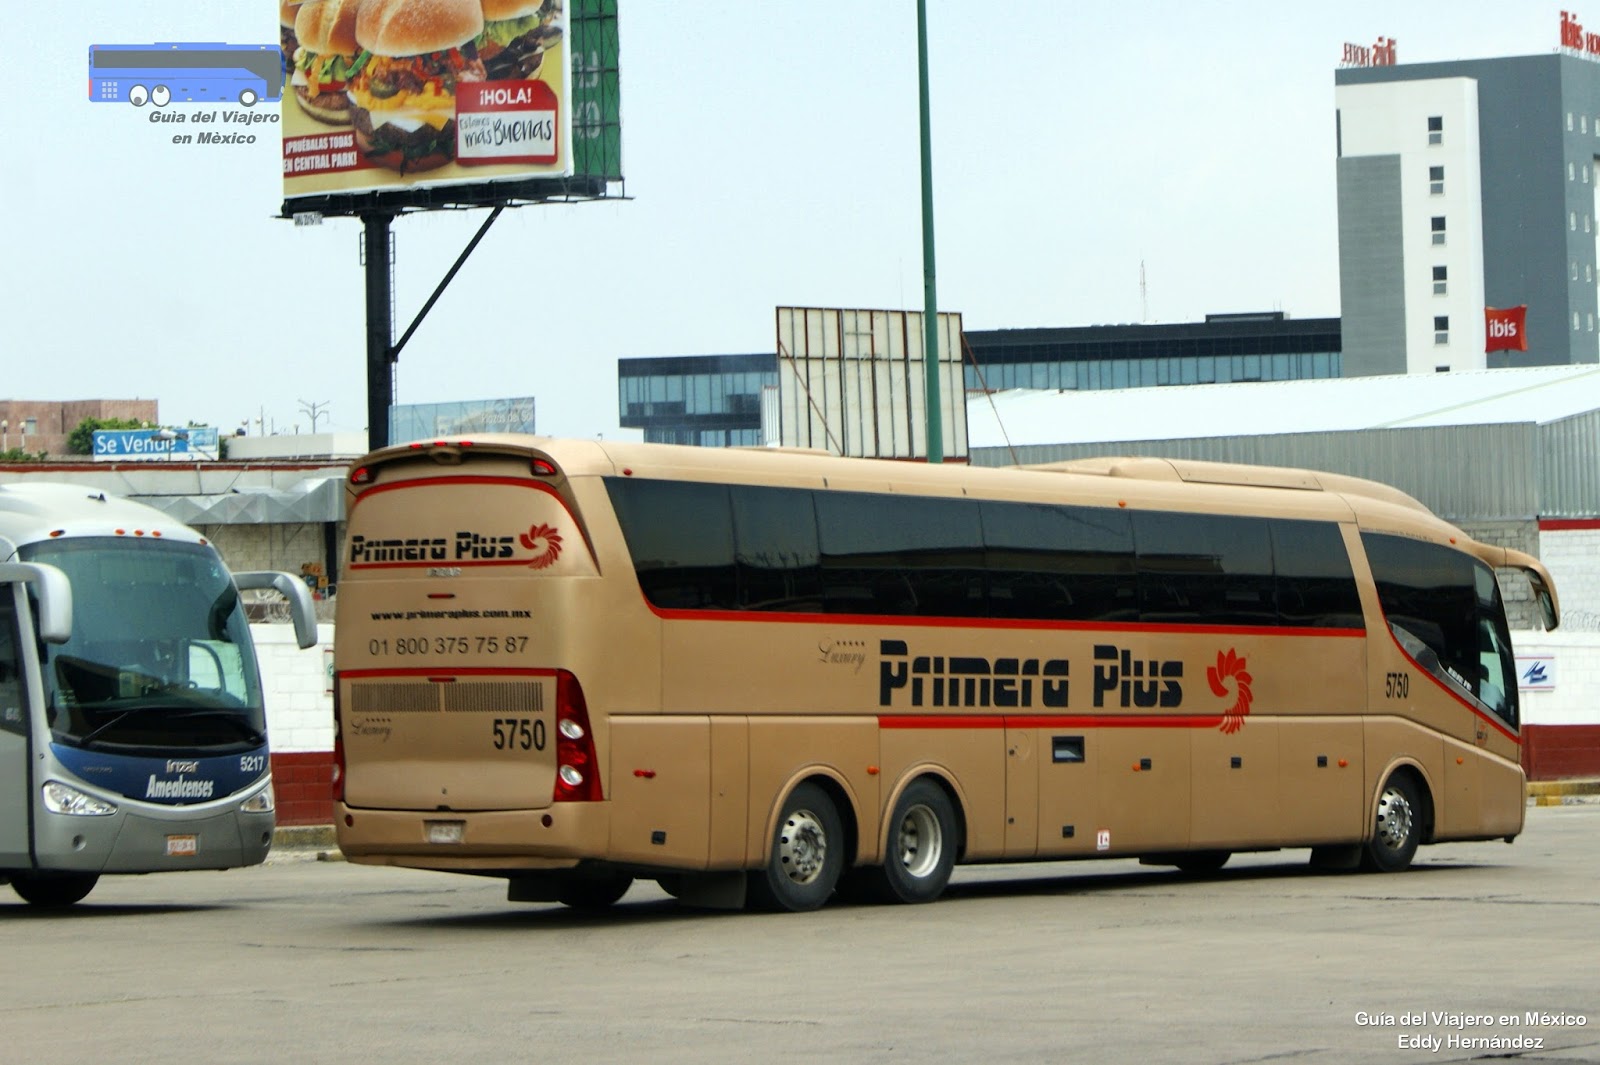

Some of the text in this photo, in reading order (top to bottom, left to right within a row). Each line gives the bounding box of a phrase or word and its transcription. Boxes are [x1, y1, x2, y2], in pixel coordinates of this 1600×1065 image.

[480, 88, 532, 105] ¡HOLA!
[329, 134, 354, 149] TODAS
[465, 118, 552, 148] más Buenas
[284, 151, 358, 173] EN CENTRAL PARK!
[1489, 318, 1517, 338] ibis
[97, 435, 117, 453] Se
[351, 532, 515, 563] Primera Plus
[370, 609, 532, 621] www.primeraplus.com.mx
[369, 635, 529, 655] 01 800 375 75 87
[879, 639, 1184, 708] Primera Plus
[1385, 672, 1409, 698] 5750
[493, 719, 546, 751] 5750
[240, 756, 265, 772] 5217
[146, 774, 214, 799] Amealcenses
